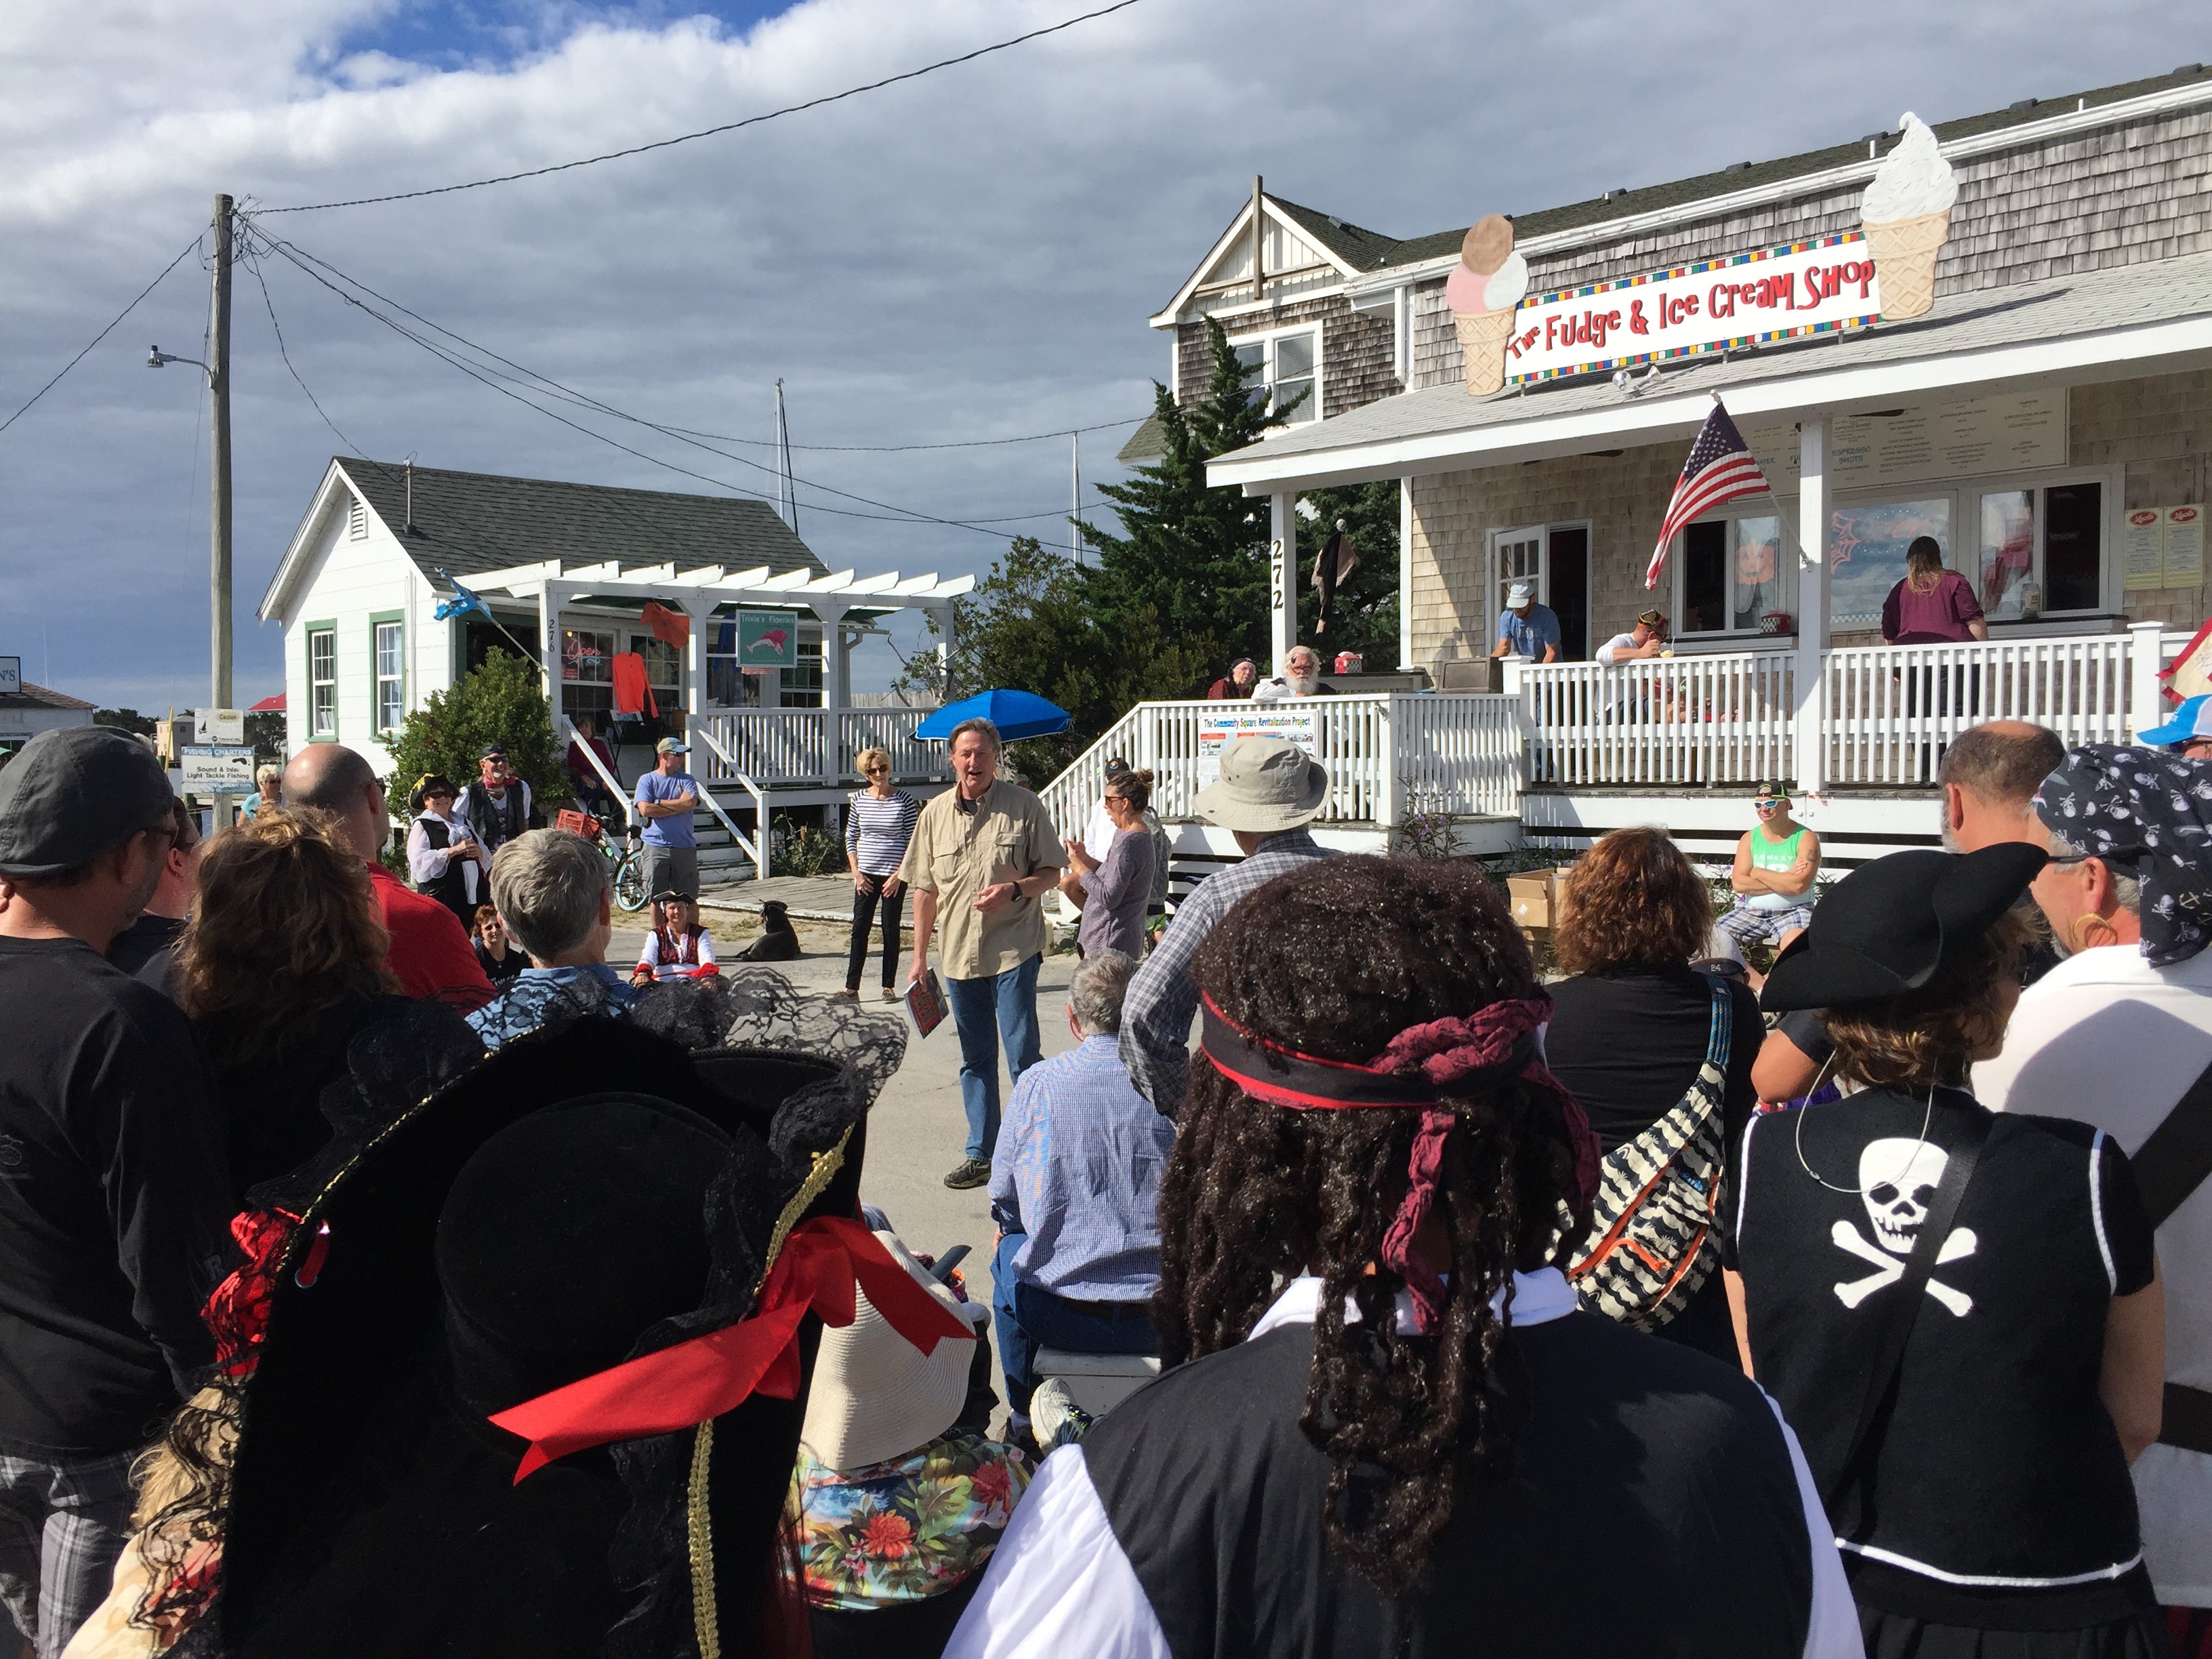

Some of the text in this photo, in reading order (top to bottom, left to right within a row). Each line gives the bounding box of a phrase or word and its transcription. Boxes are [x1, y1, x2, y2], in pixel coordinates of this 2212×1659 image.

[1630, 299, 1650, 335] &
[1660, 293, 1699, 329] Ice
[1273, 539, 1284, 610] 272
[1204, 718, 1212, 728] The
[1258, 716, 1291, 726] Revitalization
[1292, 716, 1310, 729] Project
[1711, 964, 1721, 972] 24
